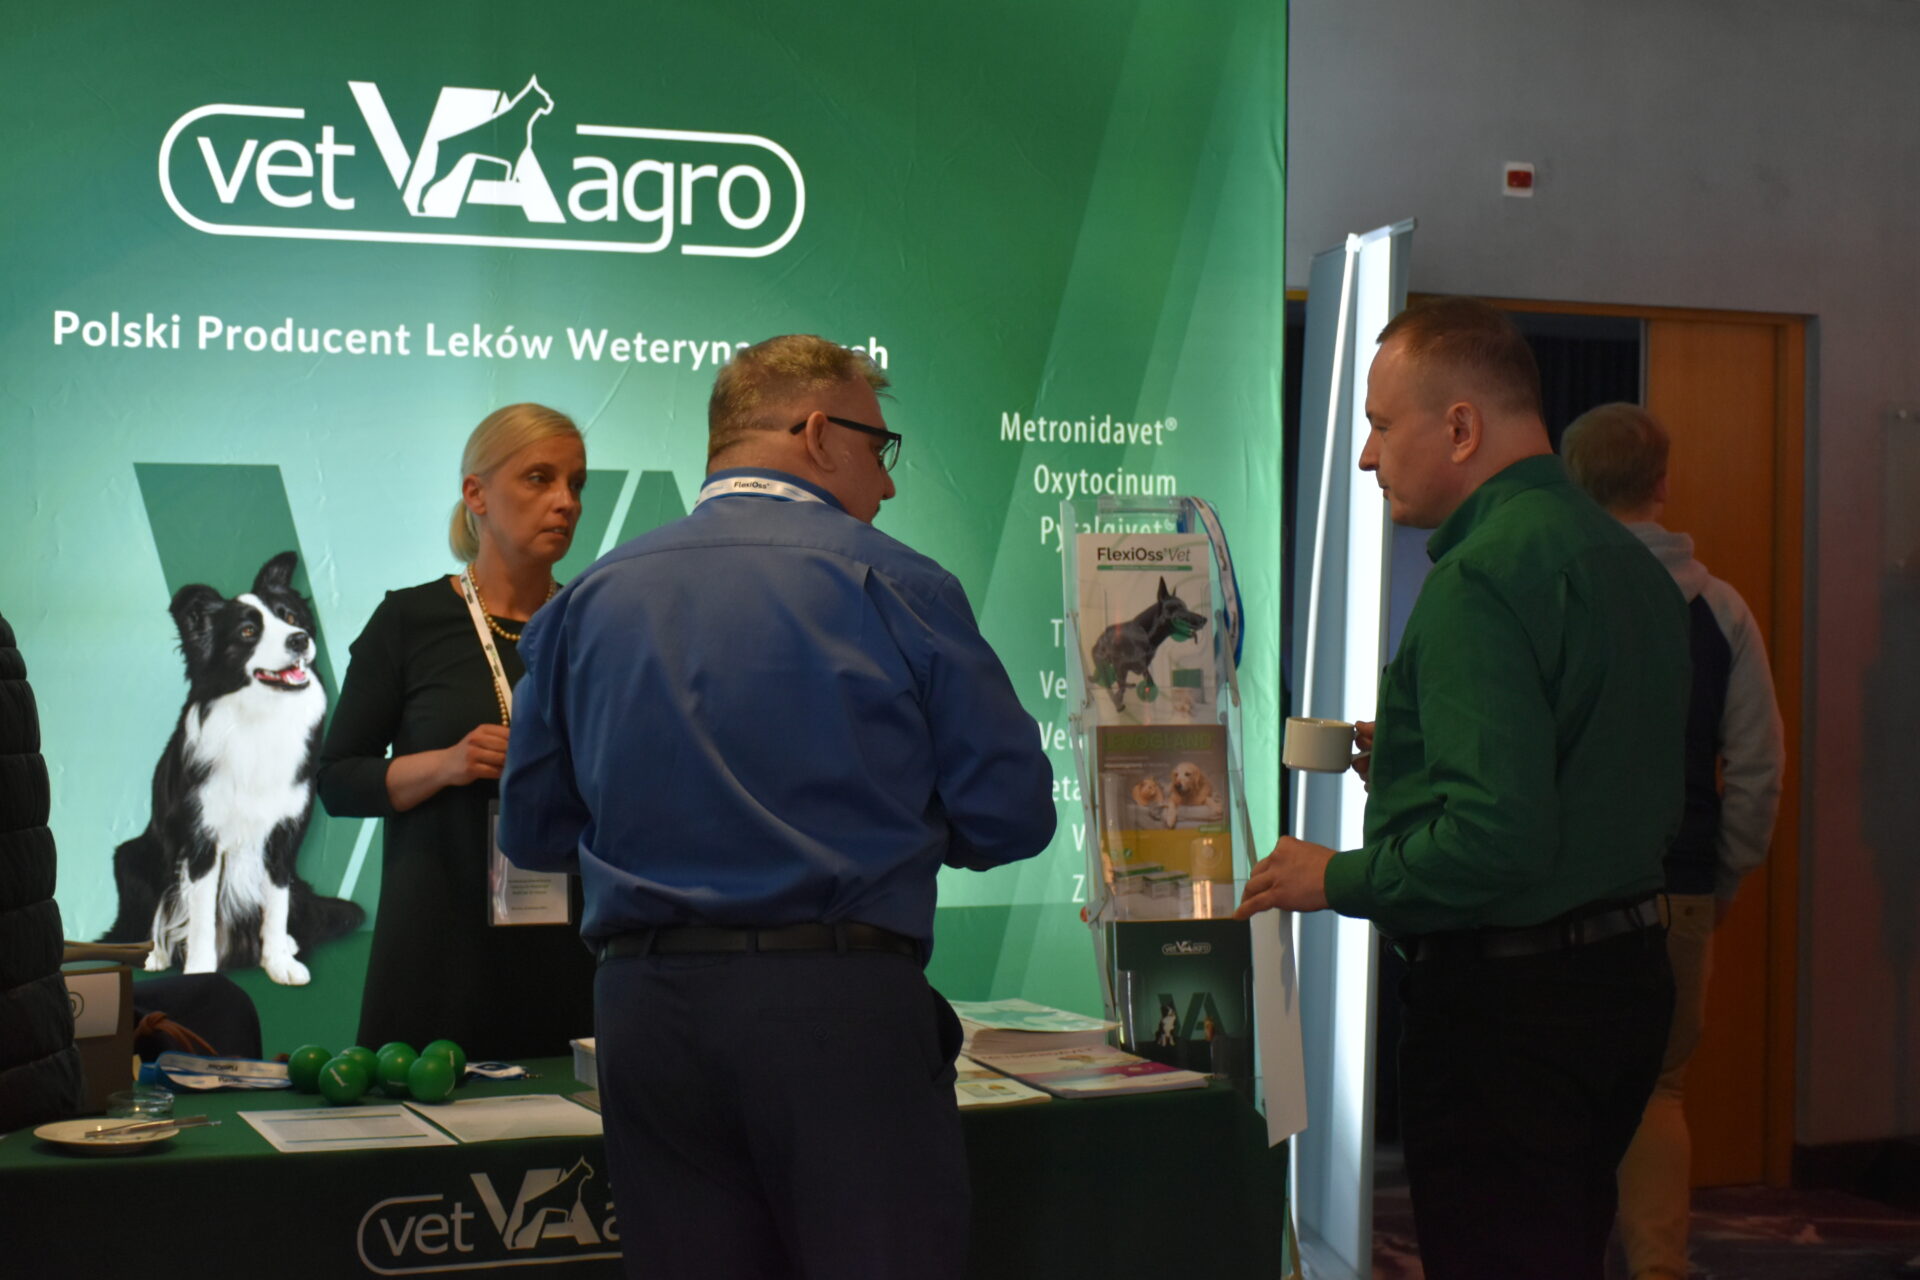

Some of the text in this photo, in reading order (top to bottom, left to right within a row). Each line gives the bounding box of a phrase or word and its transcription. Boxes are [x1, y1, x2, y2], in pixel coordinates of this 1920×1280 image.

[197, 125, 356, 210] vet
[567, 155, 772, 254] agro
[53, 309, 889, 372] Polski Producent Leków Weterynh
[1034, 464, 1177, 501] Oxytocinum
[1168, 547, 1191, 562] Vet
[379, 1202, 475, 1256] vet
